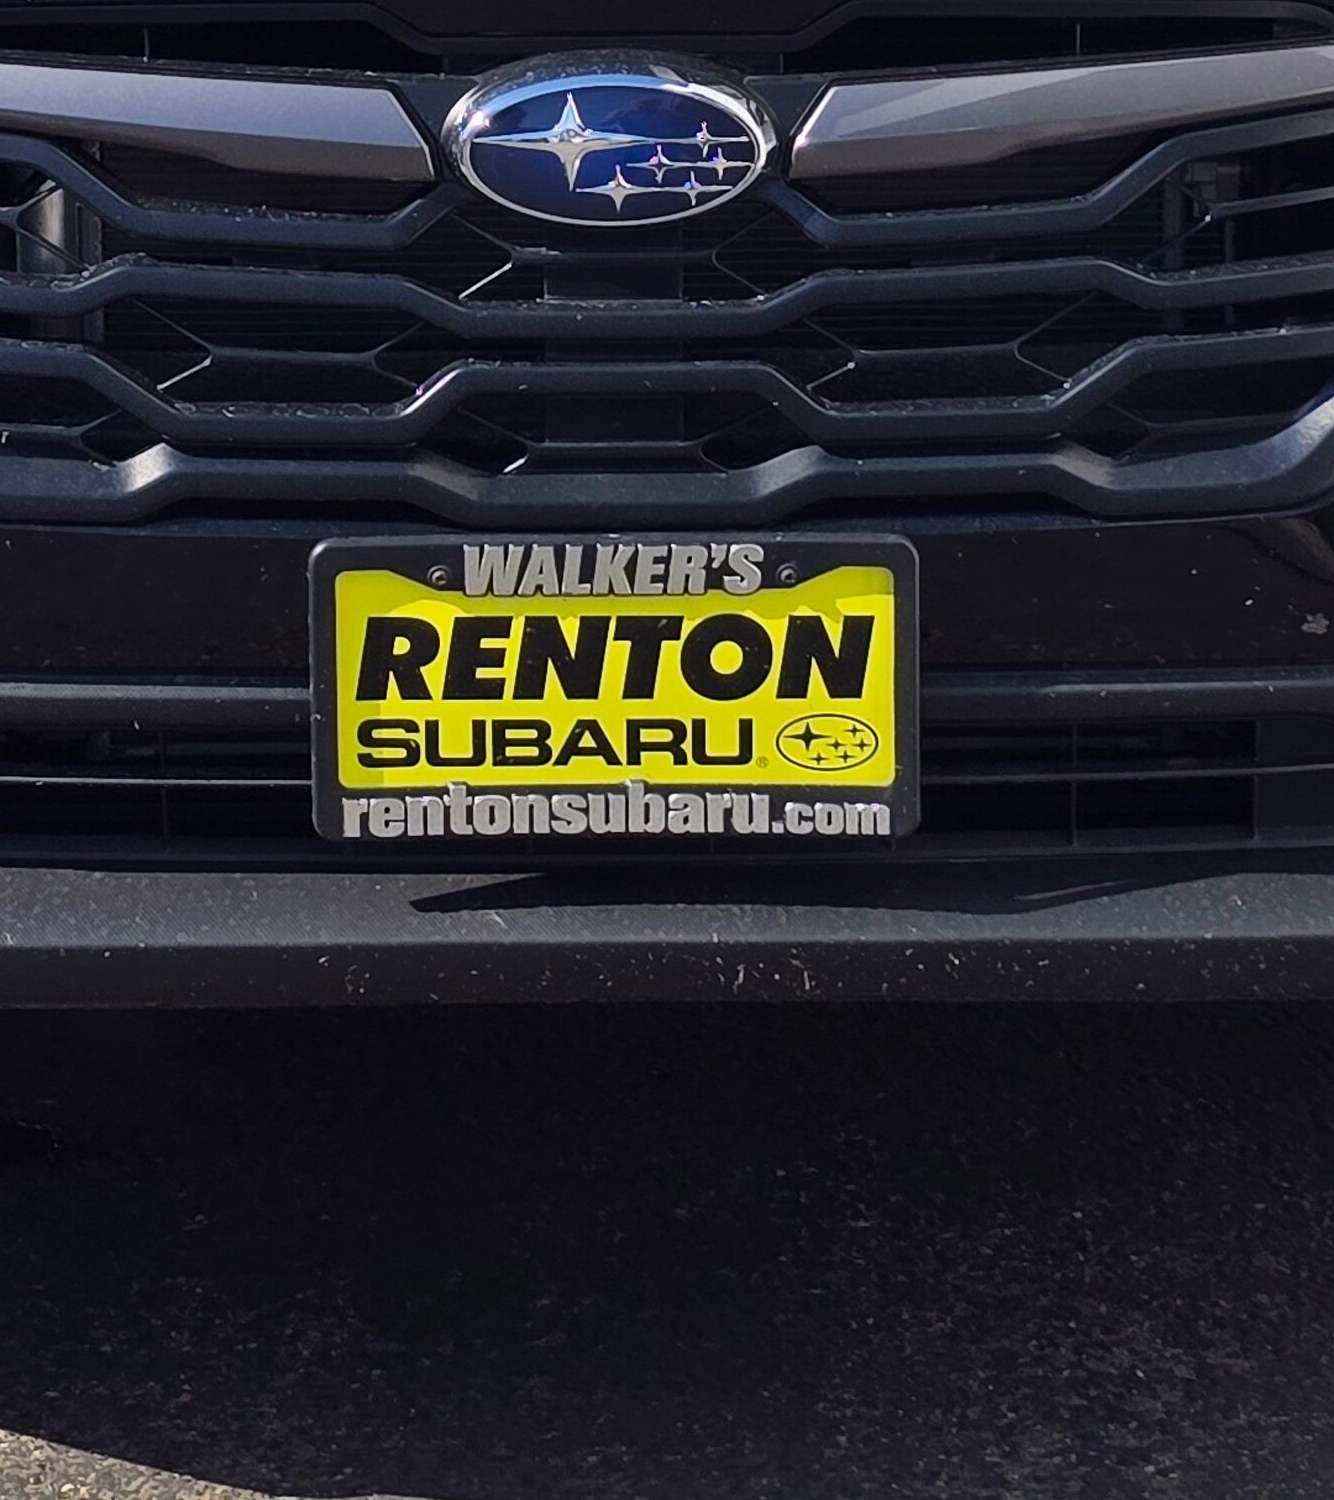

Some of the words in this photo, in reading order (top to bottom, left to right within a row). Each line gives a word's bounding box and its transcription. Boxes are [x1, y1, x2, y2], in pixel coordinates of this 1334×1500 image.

[463, 543, 764, 595] WALKER'S
[355, 613, 875, 701] RENTON
[356, 717, 754, 768] SUBARU
[341, 779, 891, 838] rentonsubaru.com
